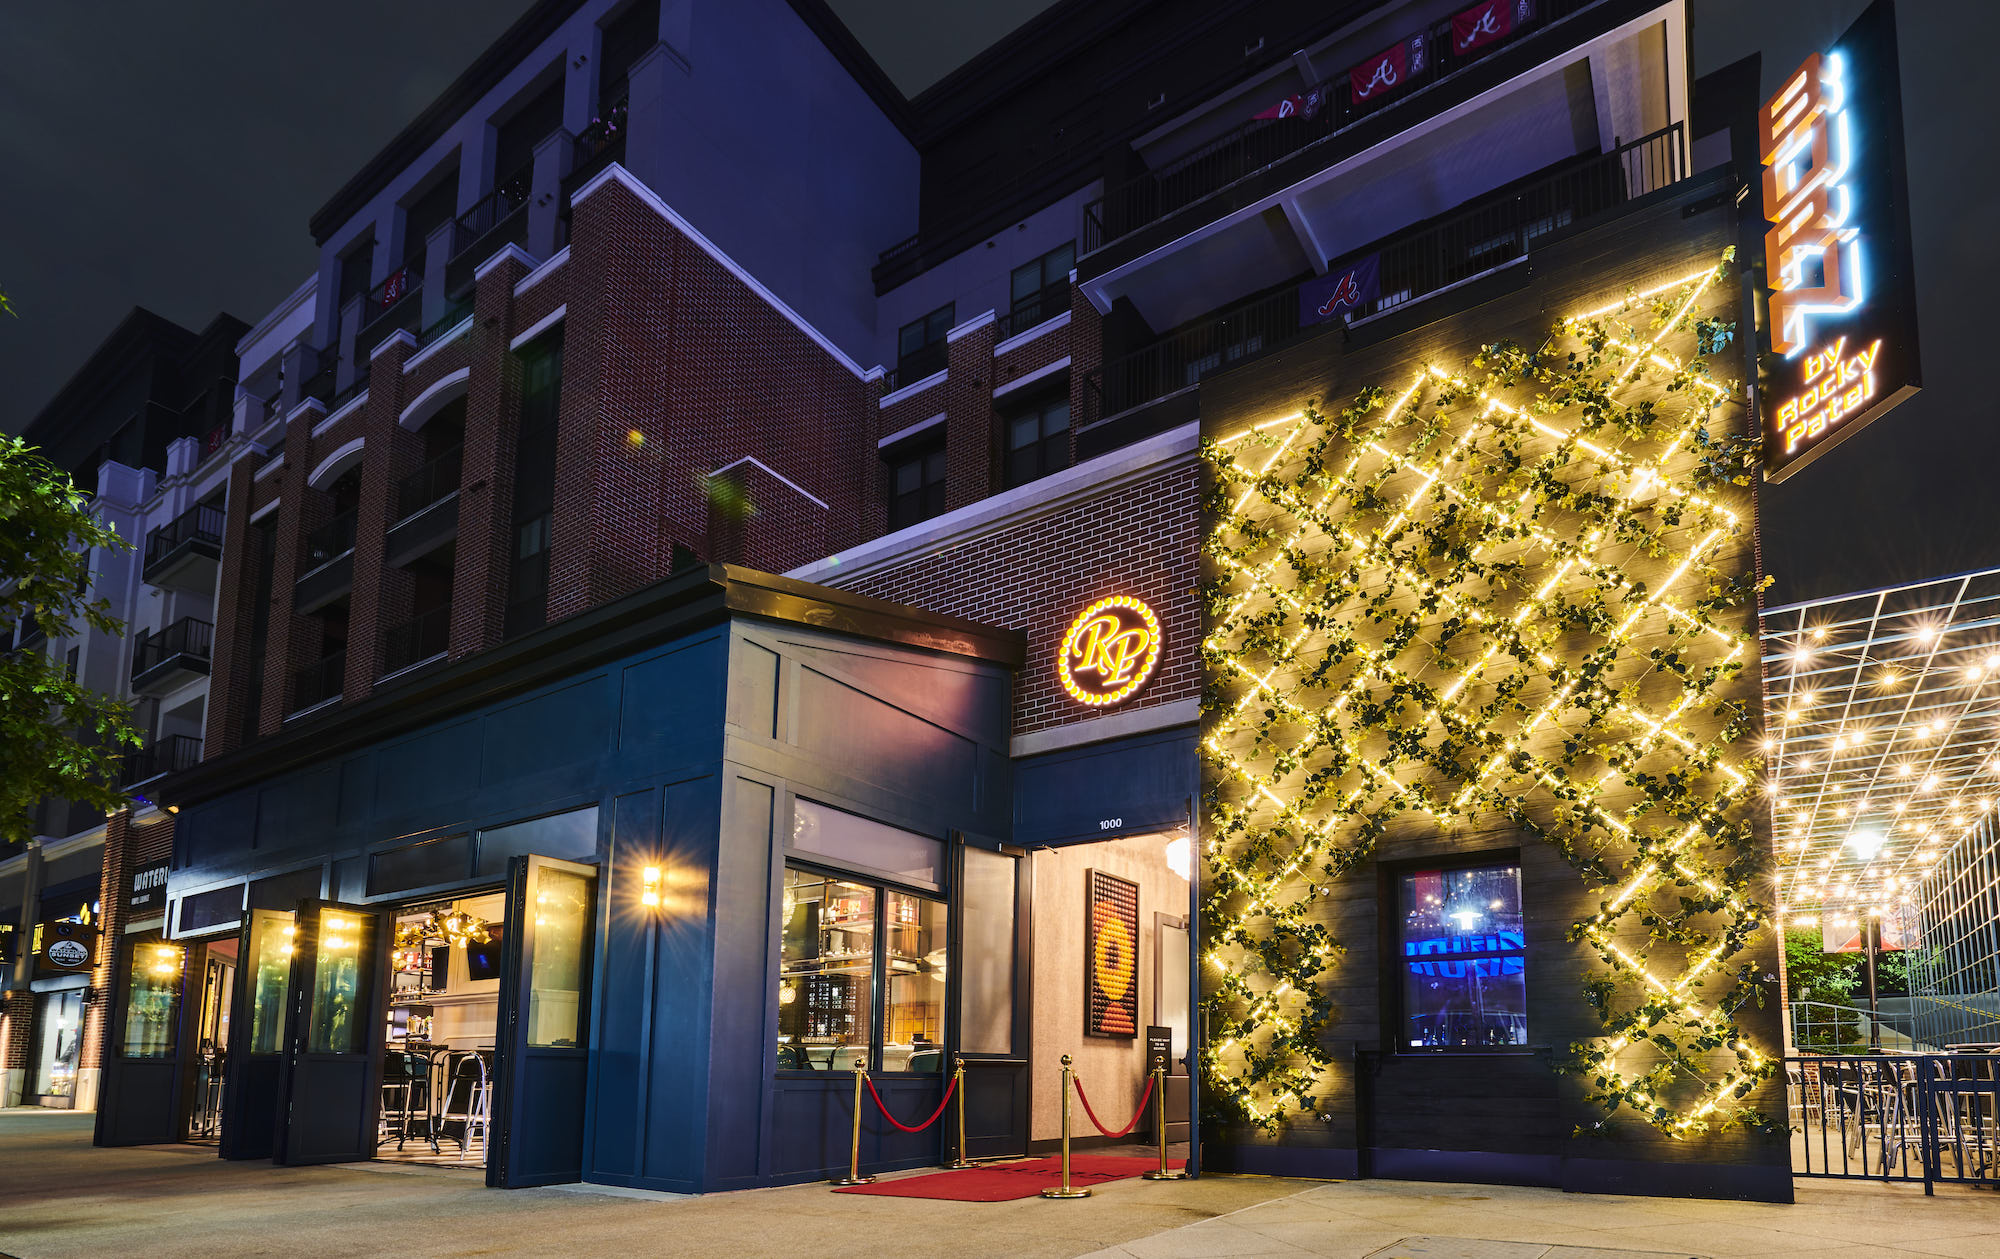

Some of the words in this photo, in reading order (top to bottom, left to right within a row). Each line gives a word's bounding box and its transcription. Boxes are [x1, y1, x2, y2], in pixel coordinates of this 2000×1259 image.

[1758, 51, 1862, 360] BURN
[1777, 339, 1881, 432] Rocky
[1804, 336, 1846, 384] by
[1785, 371, 1876, 454] Patel
[1072, 615, 1150, 687] RP
[1099, 818, 1123, 831] 1000
